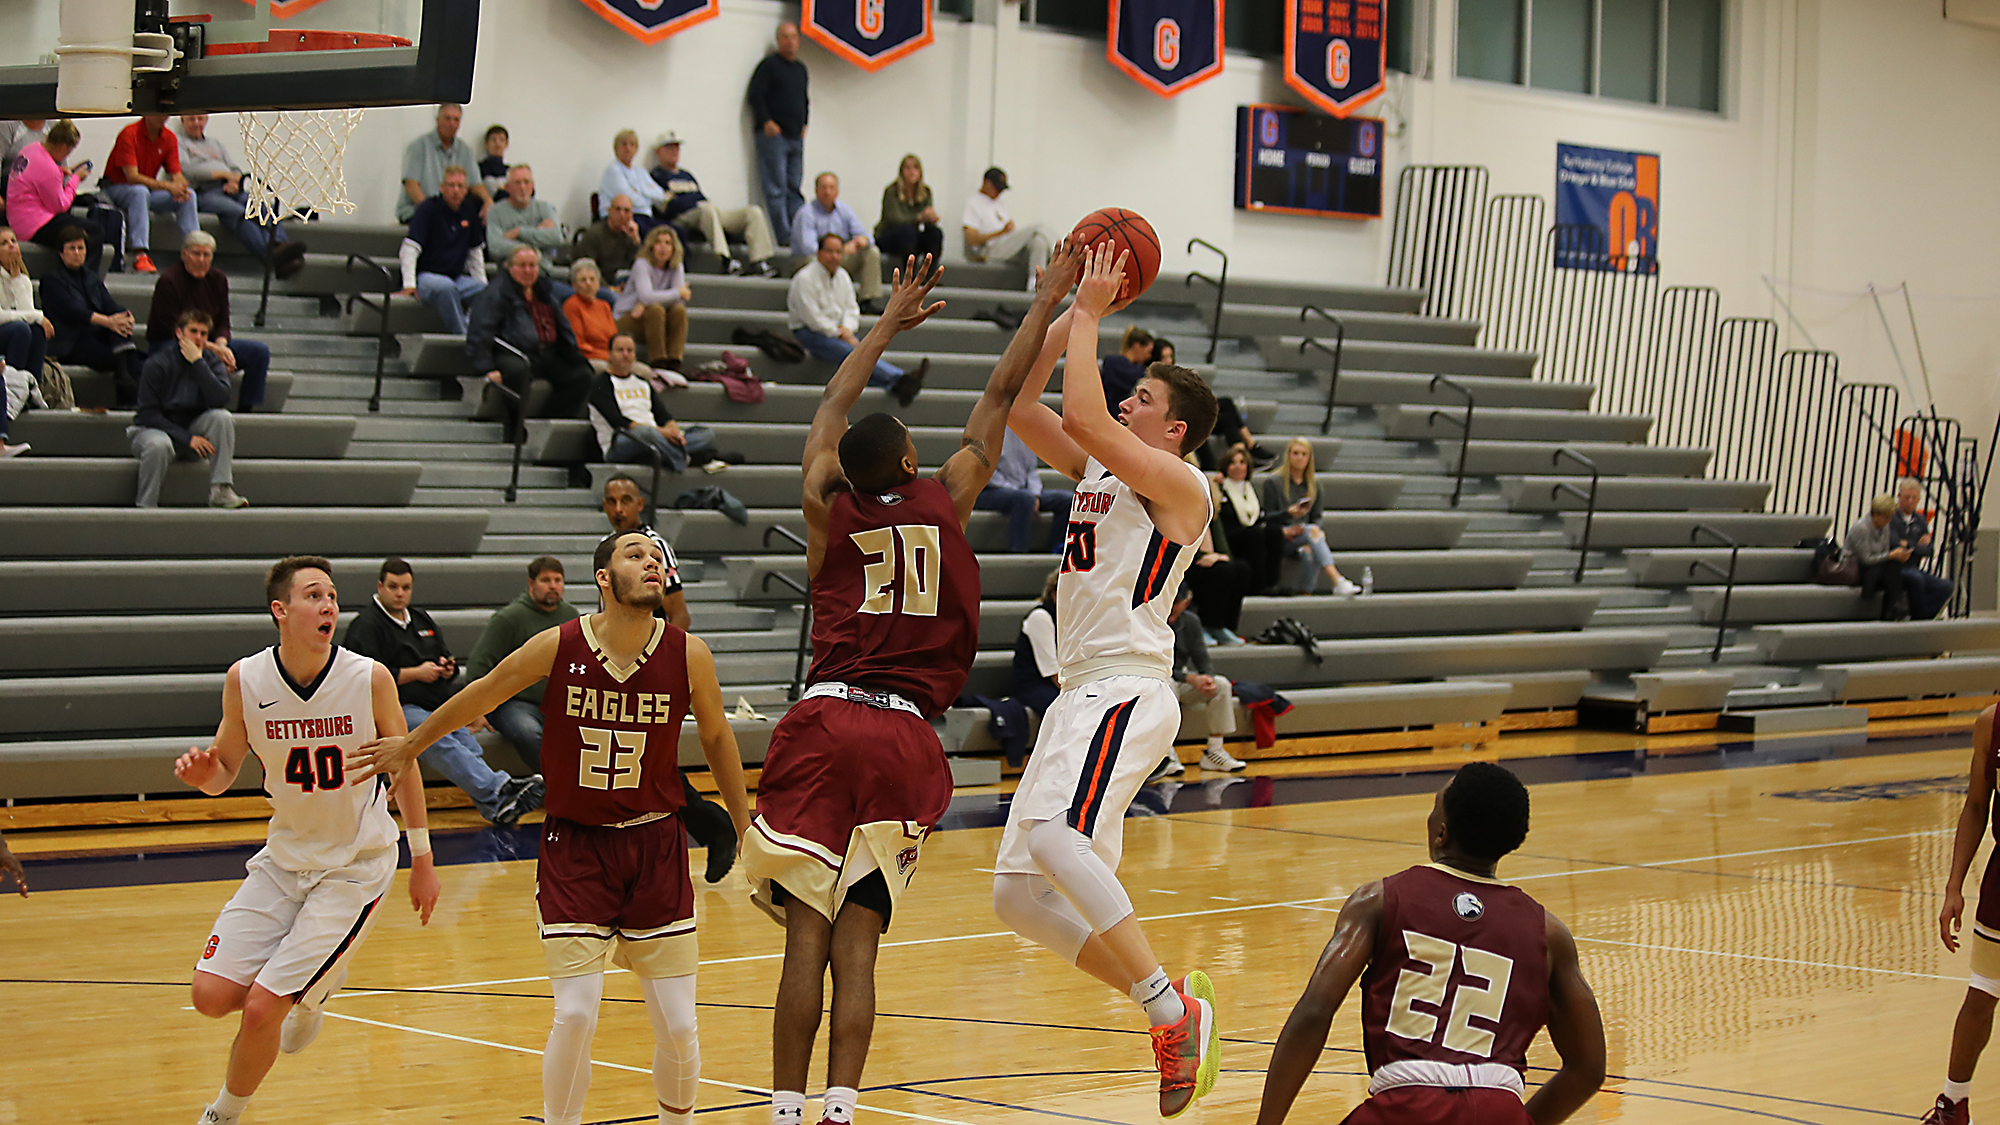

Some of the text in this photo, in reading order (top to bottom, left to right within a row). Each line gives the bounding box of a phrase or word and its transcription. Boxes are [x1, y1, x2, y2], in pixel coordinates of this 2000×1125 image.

[1154, 18, 1181, 70] G
[1326, 38, 1351, 89] G
[1261, 110, 1279, 147] G
[1359, 121, 1376, 157] G
[1258, 148, 1285, 167] HOME
[1348, 157, 1376, 176] GUEST
[849, 525, 941, 616] 20
[566, 685, 671, 724] EAGLES
[265, 715, 353, 740] GETTYSBURG
[285, 744, 345, 793] 40
[579, 725, 647, 791] 23
[203, 934, 219, 960] G
[1385, 930, 1514, 1058] 22
